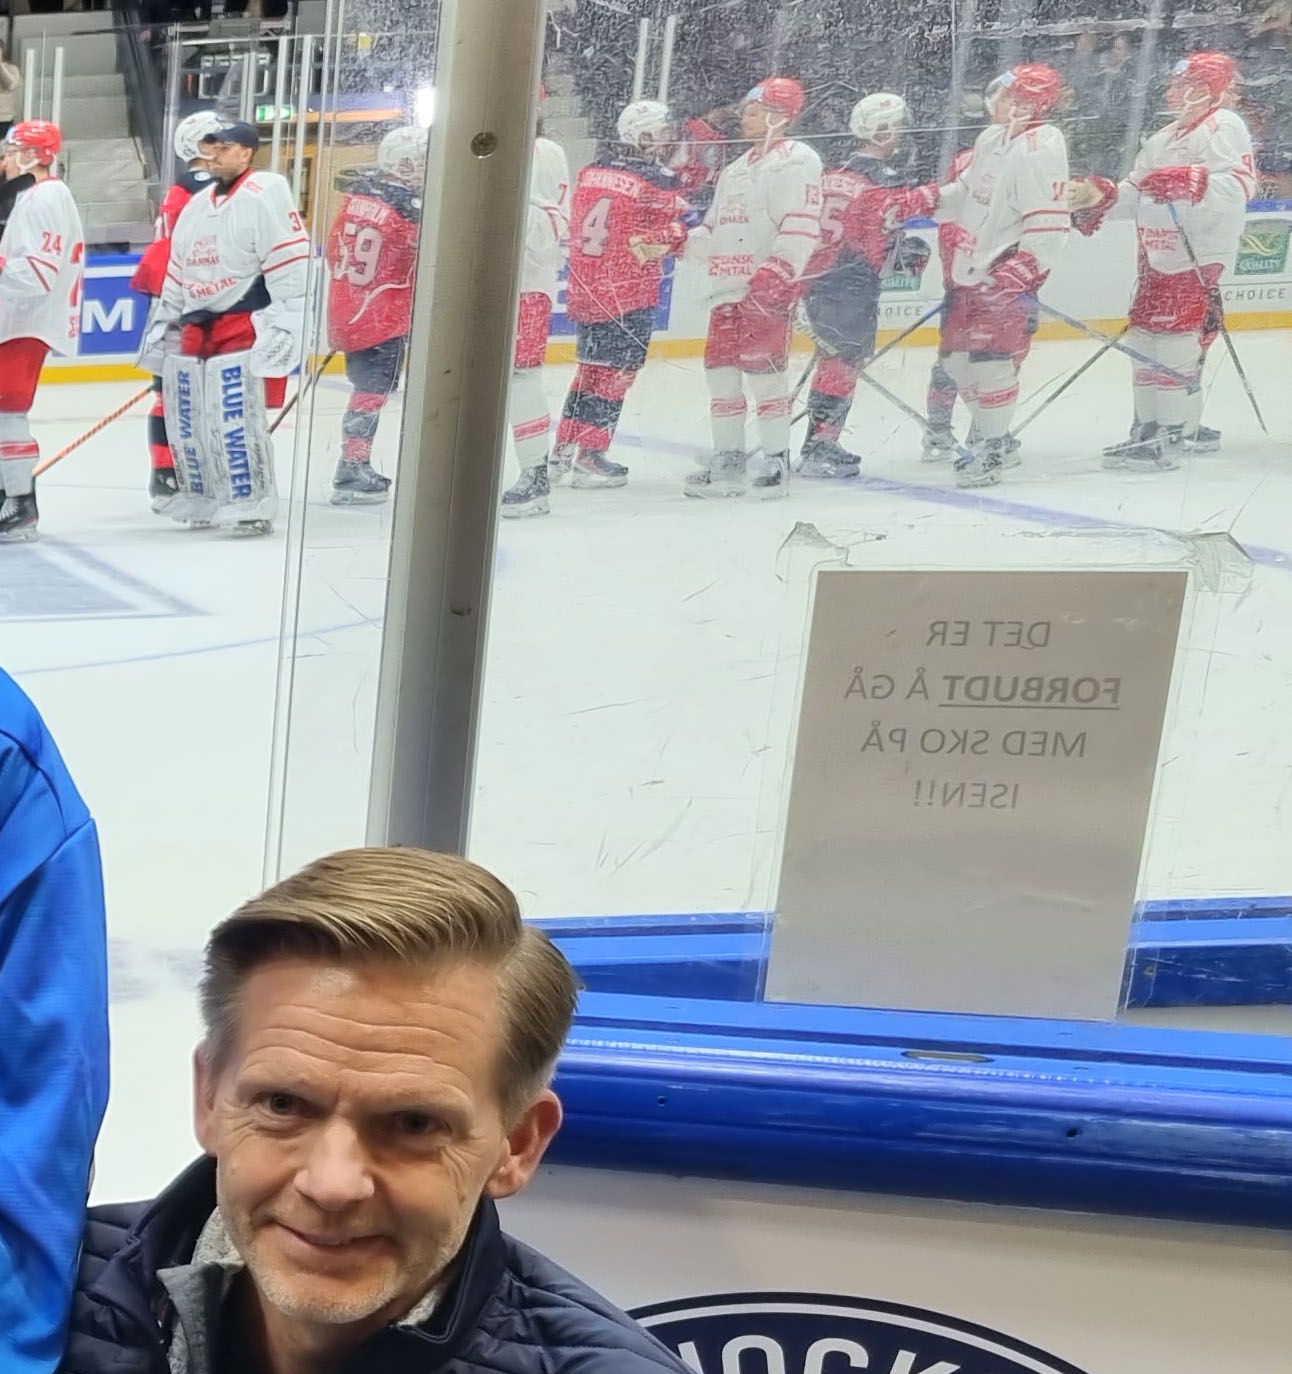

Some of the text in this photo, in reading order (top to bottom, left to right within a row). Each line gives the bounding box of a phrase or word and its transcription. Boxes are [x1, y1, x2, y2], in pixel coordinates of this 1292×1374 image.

[42, 231, 62, 255] 24
[1224, 287, 1287, 302] CHOICE
[177, 370, 193, 440] WATER
[221, 364, 253, 500] BLUE WATER
